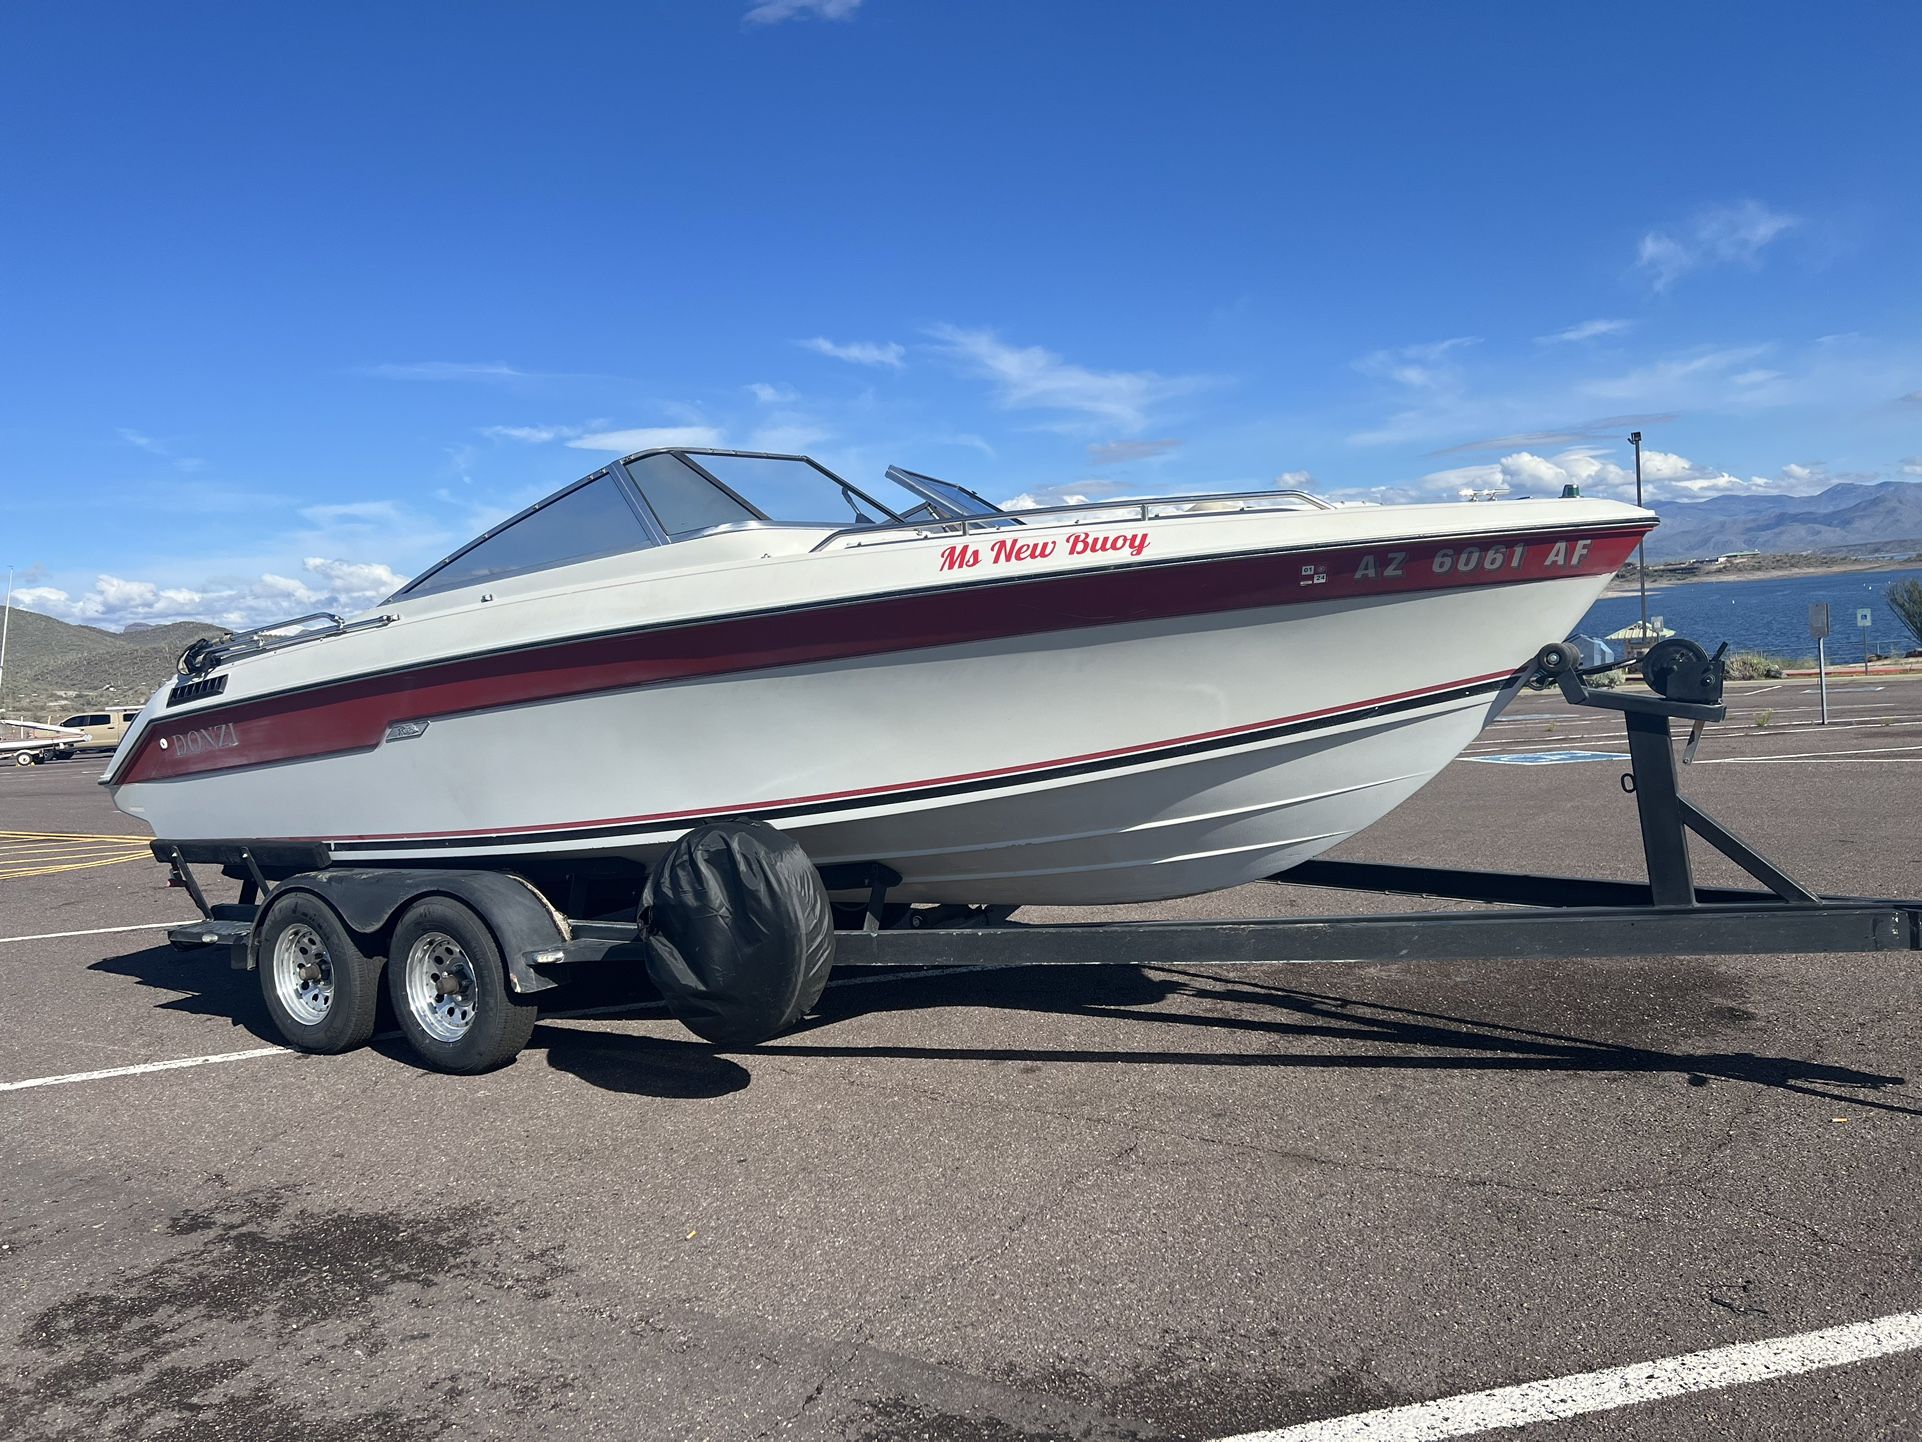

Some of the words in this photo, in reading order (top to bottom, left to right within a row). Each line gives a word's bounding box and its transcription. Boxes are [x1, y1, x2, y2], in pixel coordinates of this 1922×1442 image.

[939, 544, 982, 572] Ms
[990, 538, 1056, 564] New
[1065, 531, 1151, 556] Buoy
[1353, 551, 1408, 580] AZ
[1431, 543, 1527, 573] 6061
[1544, 539, 1593, 567] AF
[172, 722, 239, 758] DONZI
